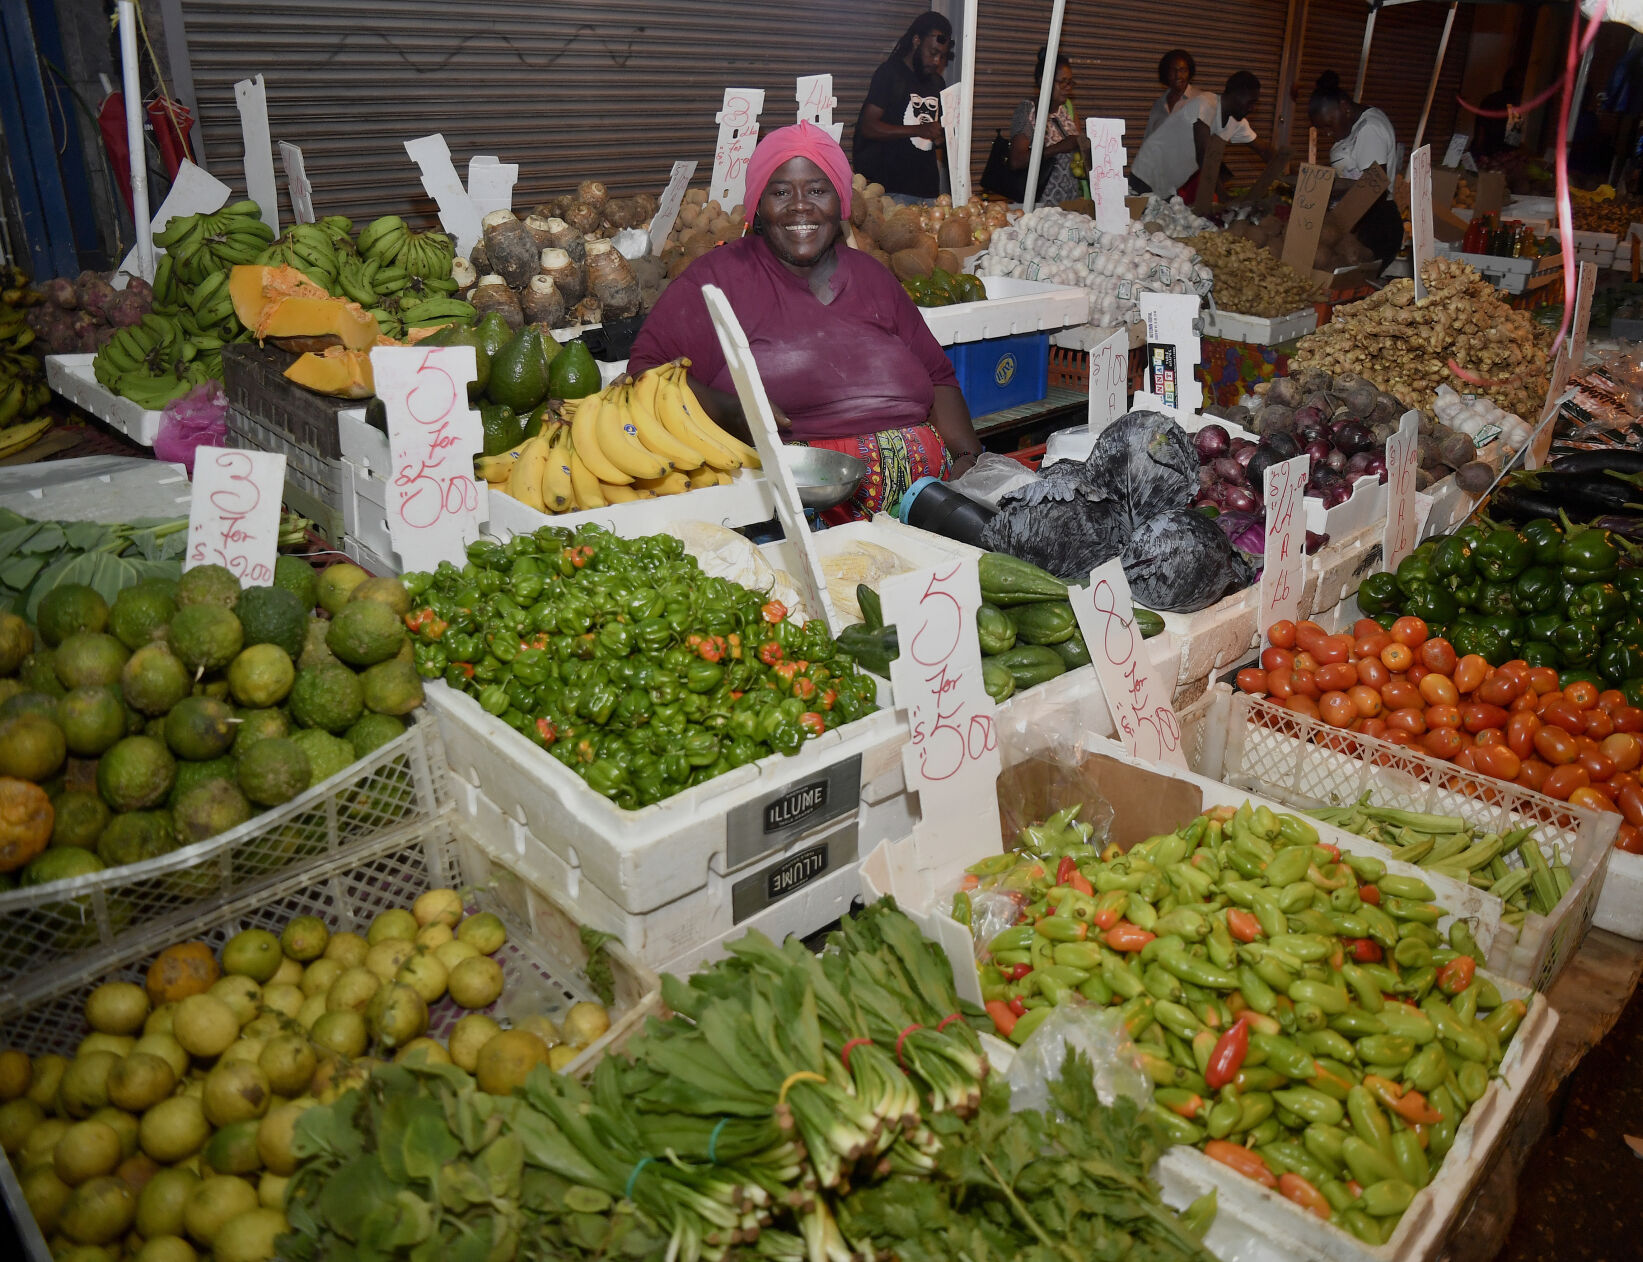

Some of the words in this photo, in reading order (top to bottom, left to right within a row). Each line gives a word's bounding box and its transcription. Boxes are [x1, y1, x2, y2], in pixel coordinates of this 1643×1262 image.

[721, 96, 751, 128] 3
[406, 346, 457, 425] 5
[210, 452, 260, 515] 3
[1280, 532, 1290, 562] A
[911, 562, 962, 667] 5
[1093, 579, 1134, 666] 8
[769, 787, 823, 823] ILLUME
[773, 854, 822, 892] ILLUME
